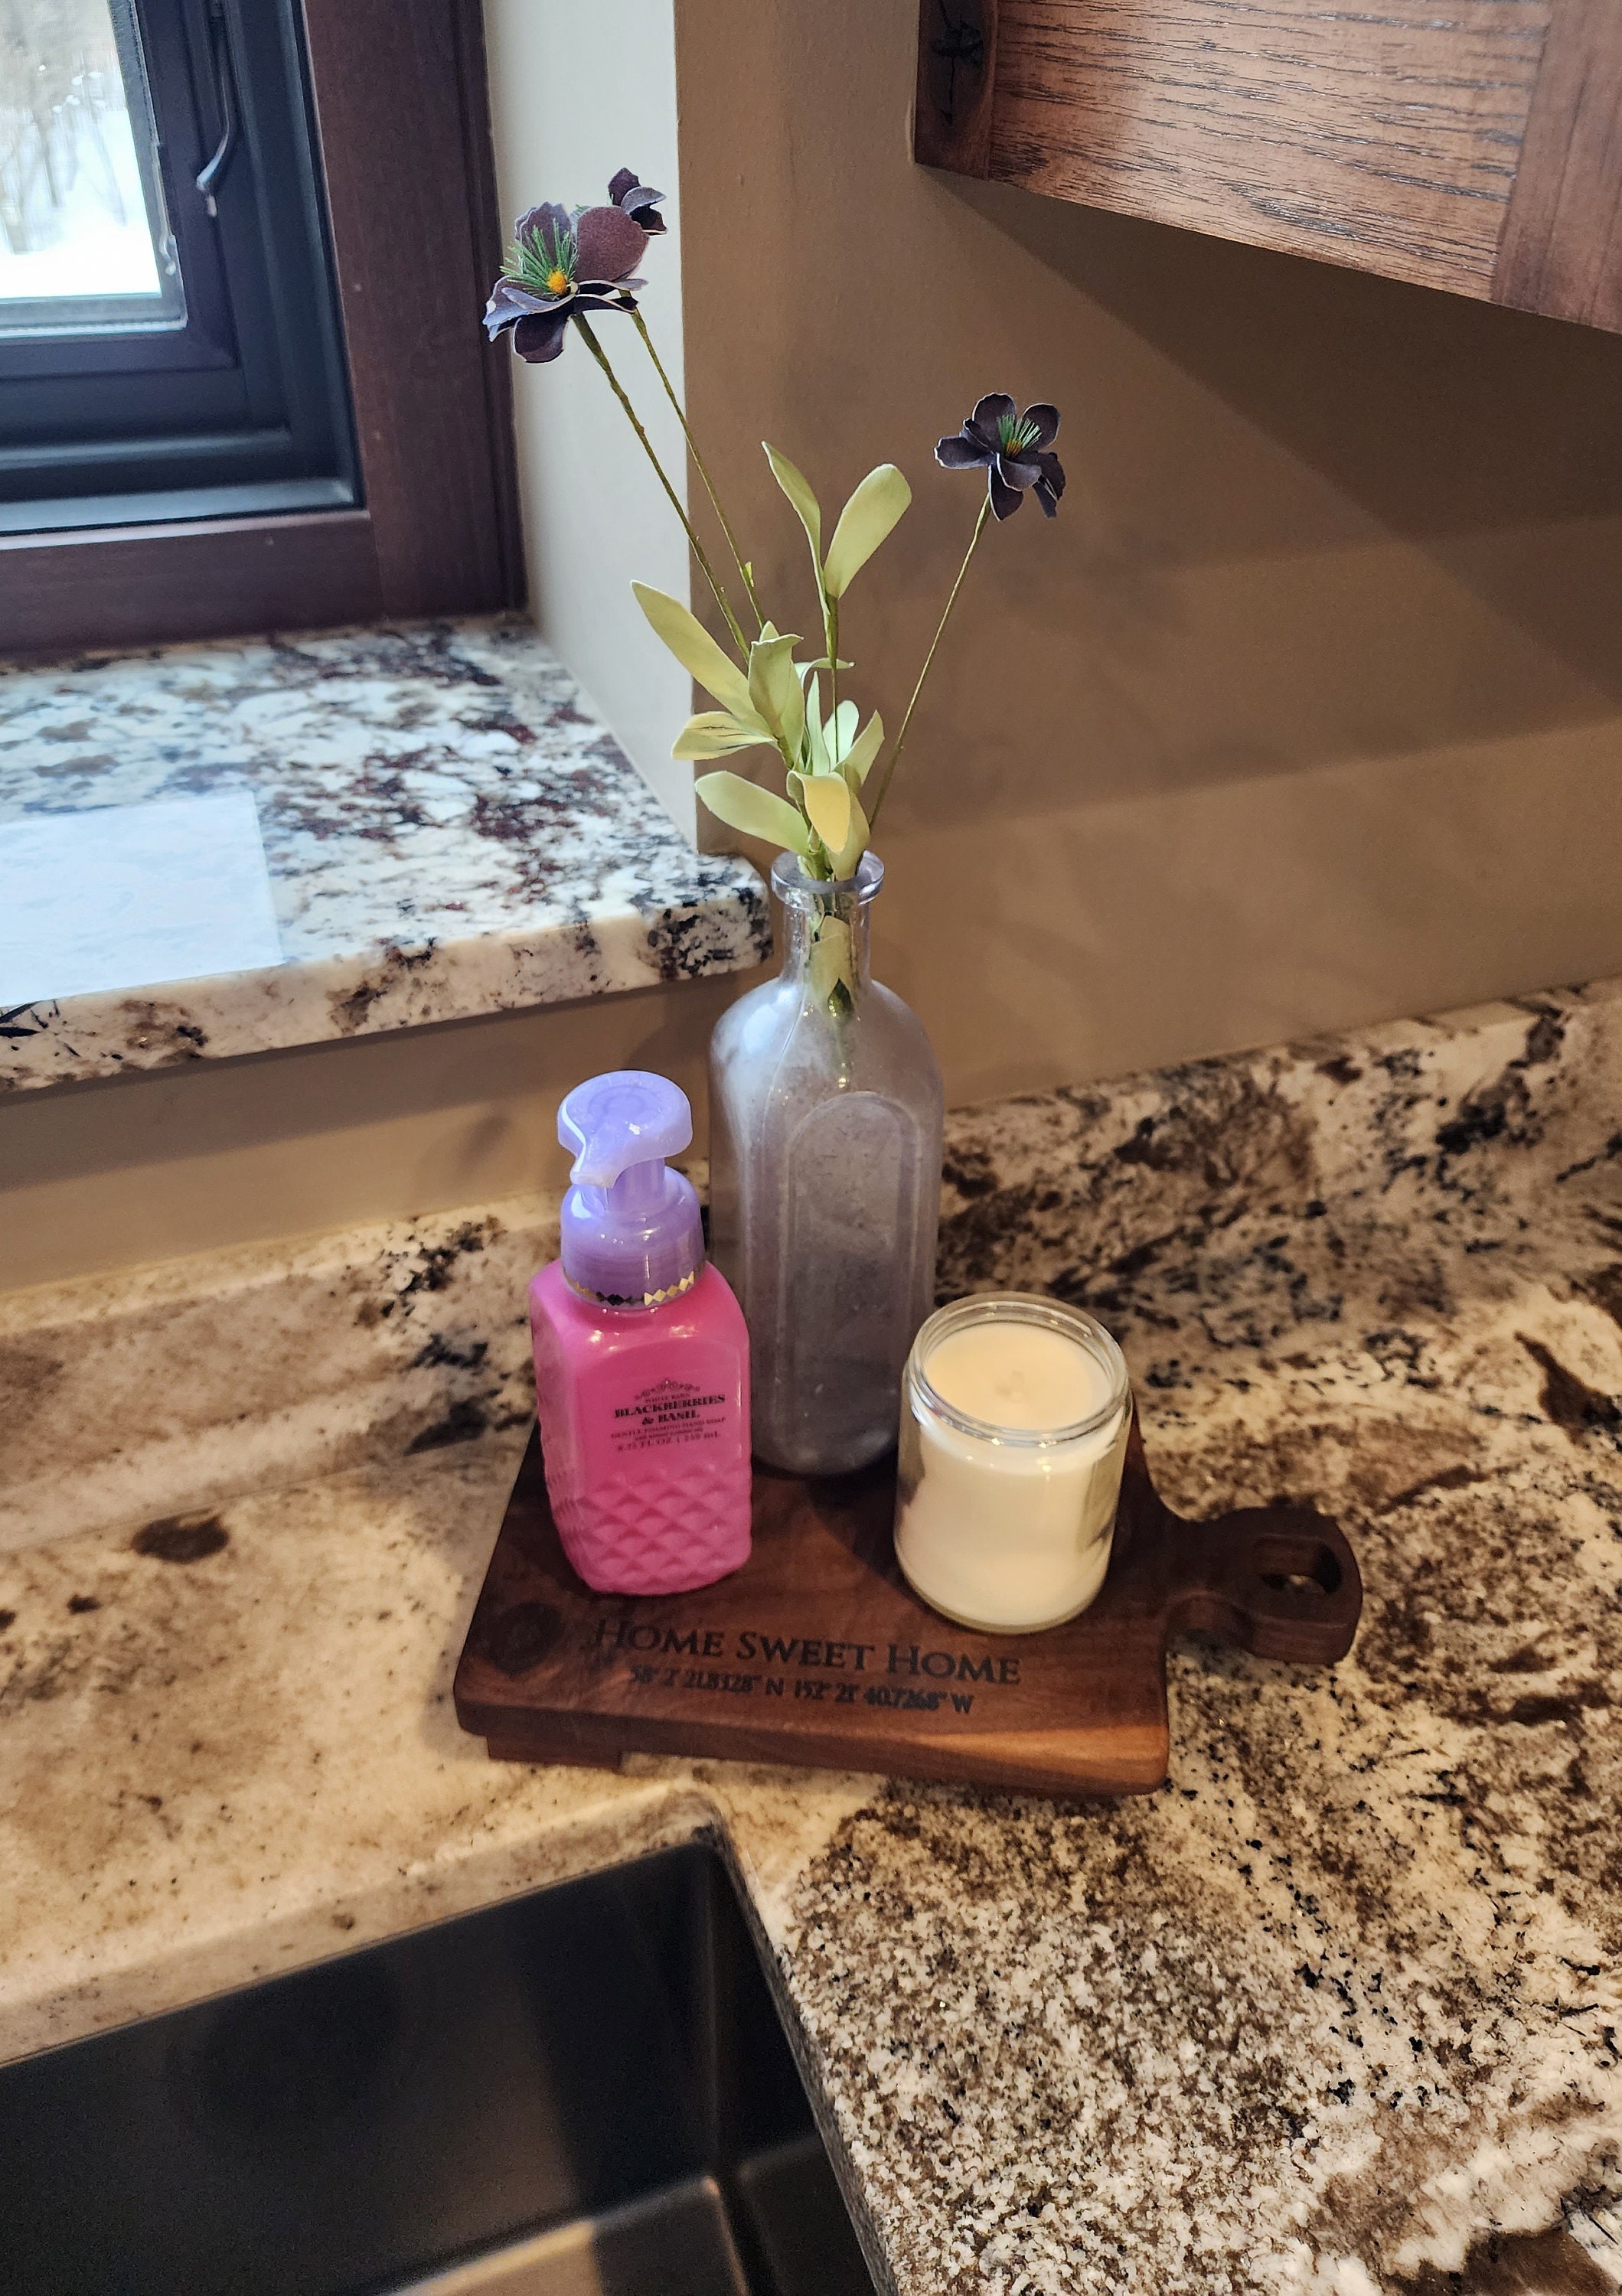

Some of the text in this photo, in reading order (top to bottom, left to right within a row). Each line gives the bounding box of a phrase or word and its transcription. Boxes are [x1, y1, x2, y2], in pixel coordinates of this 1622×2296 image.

[614, 1394, 726, 1418] BLACKBERRIES
[641, 1409, 700, 1426] & BASIL
[594, 1618, 1022, 1685] HOME SWEET HOME
[951, 1692, 975, 1714] W
